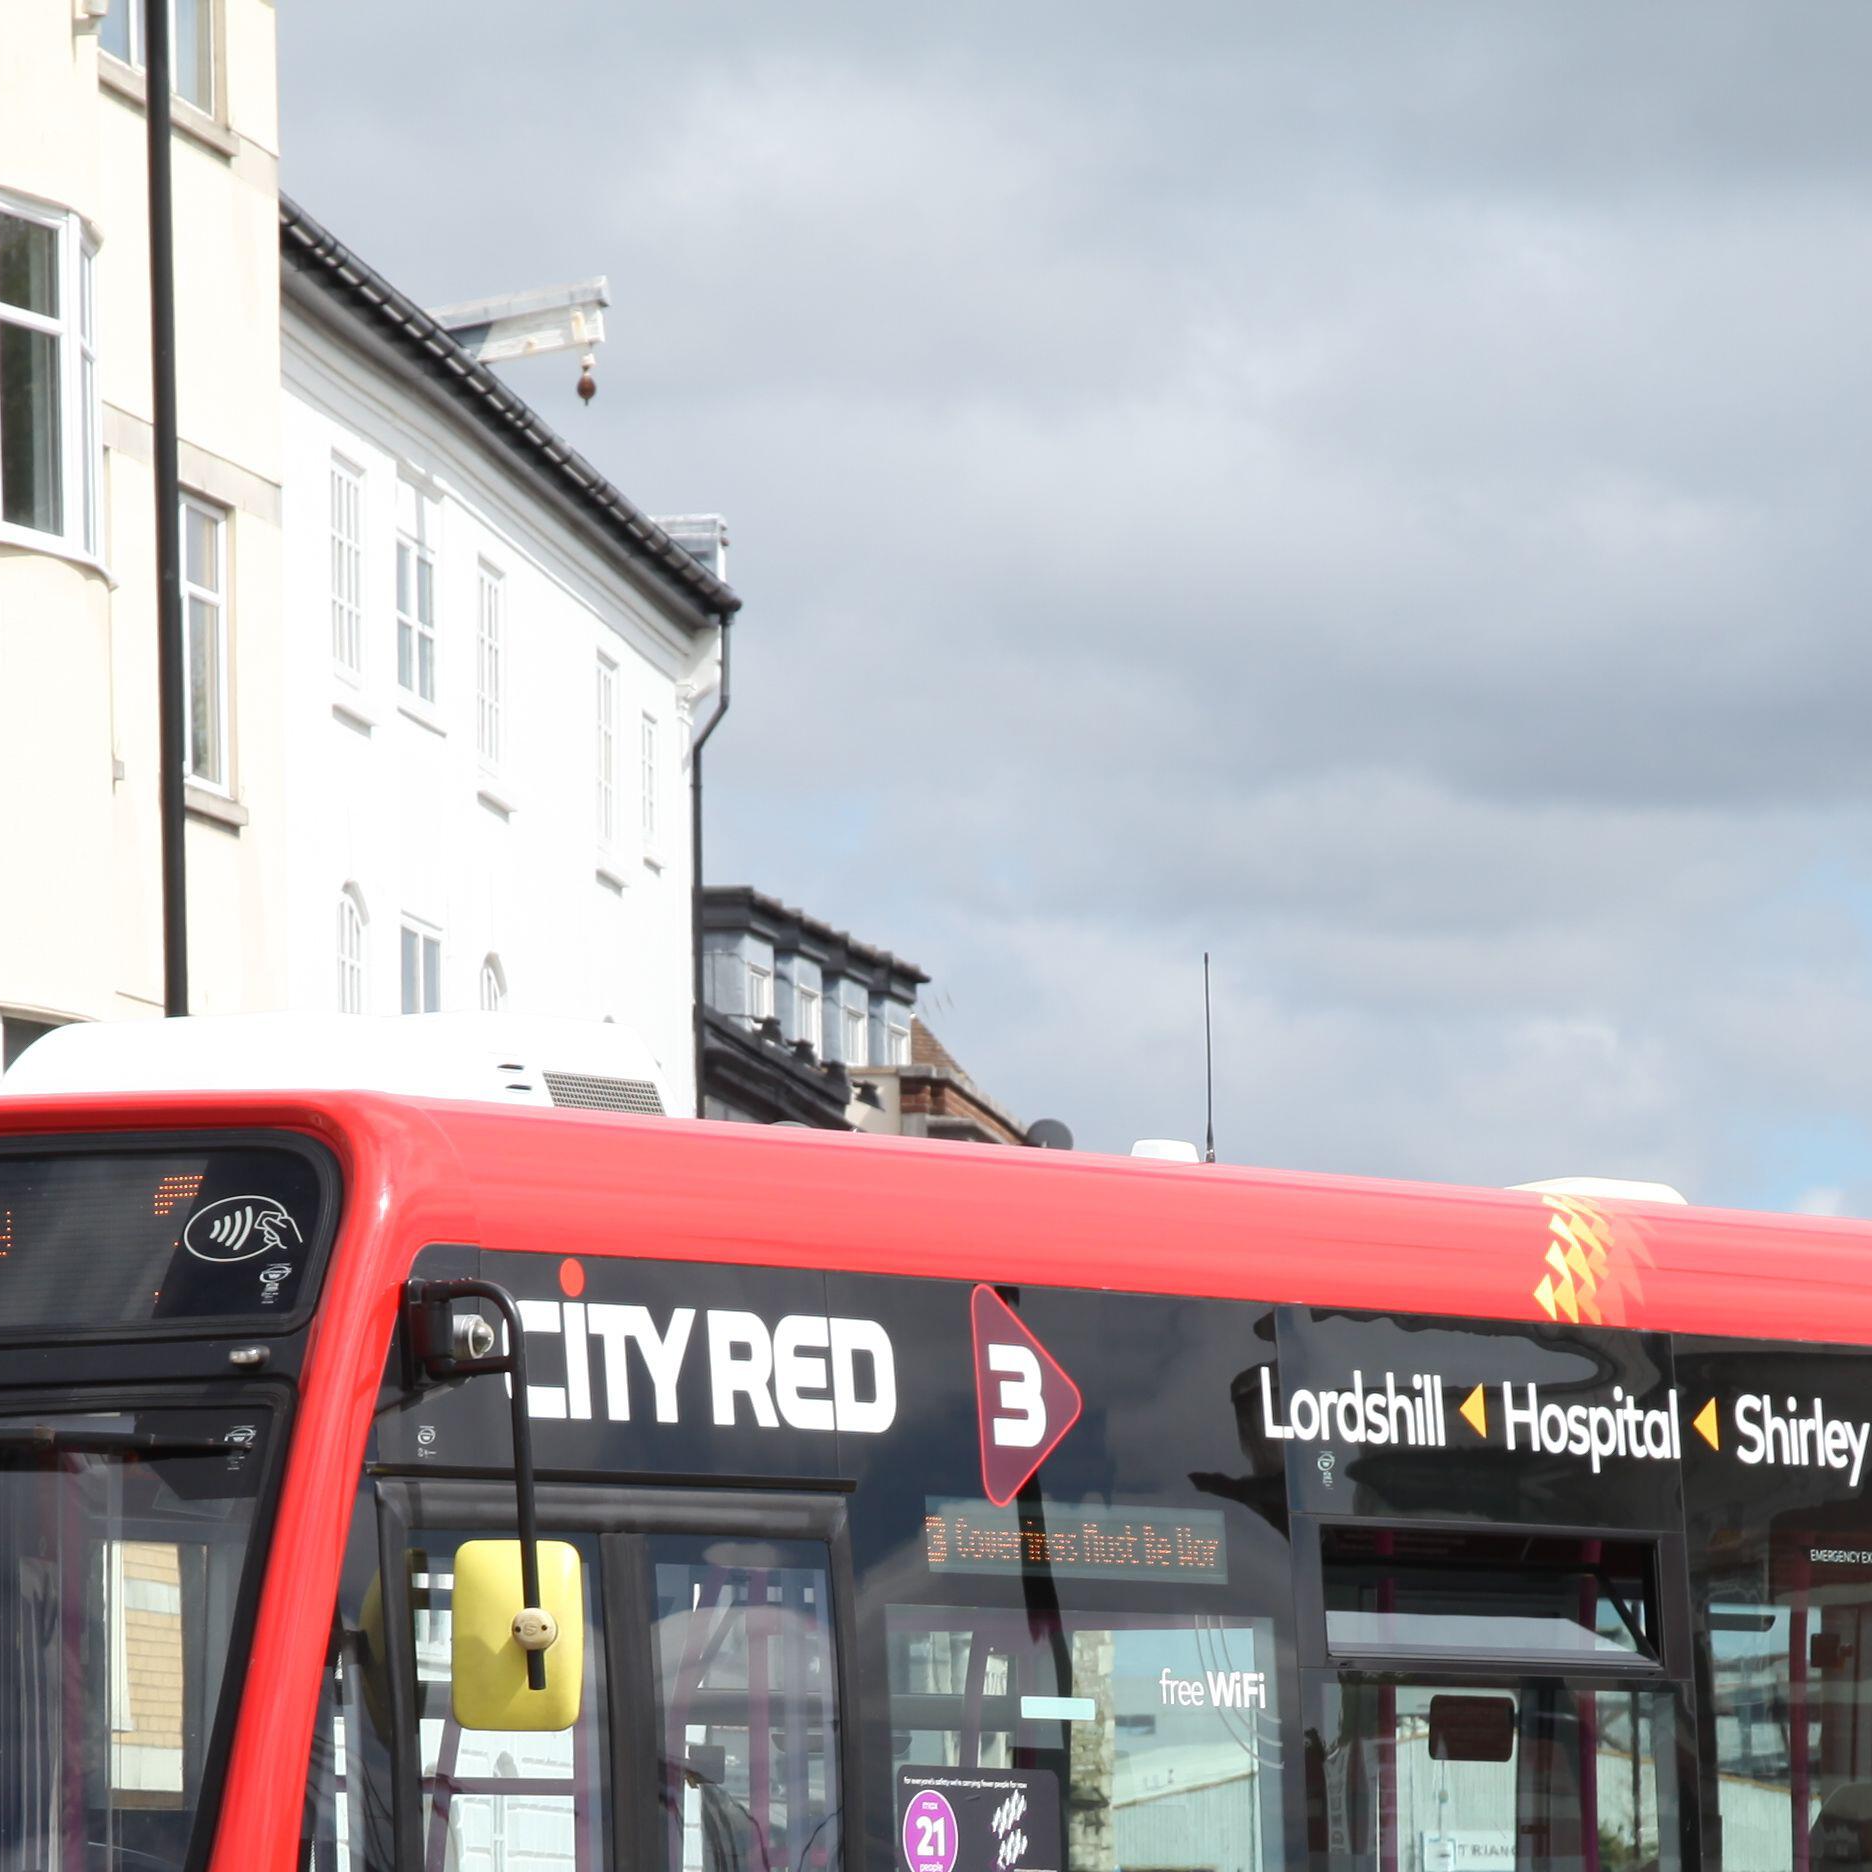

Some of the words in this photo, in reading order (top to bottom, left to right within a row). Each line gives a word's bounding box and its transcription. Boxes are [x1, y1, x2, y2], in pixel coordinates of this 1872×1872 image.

[706, 1308, 897, 1434] RED
[988, 1343, 1046, 1449] 3
[1259, 1366, 1445, 1449] Lordshill
[1503, 1381, 1681, 1474] Hospital
[1735, 1394, 1871, 1487] Shirley
[1810, 1549, 1860, 1563] EMERGENCY
[1159, 1668, 1205, 1707] free
[1206, 1671, 1267, 1709] WiFi
[915, 1815, 946, 1857] 21
